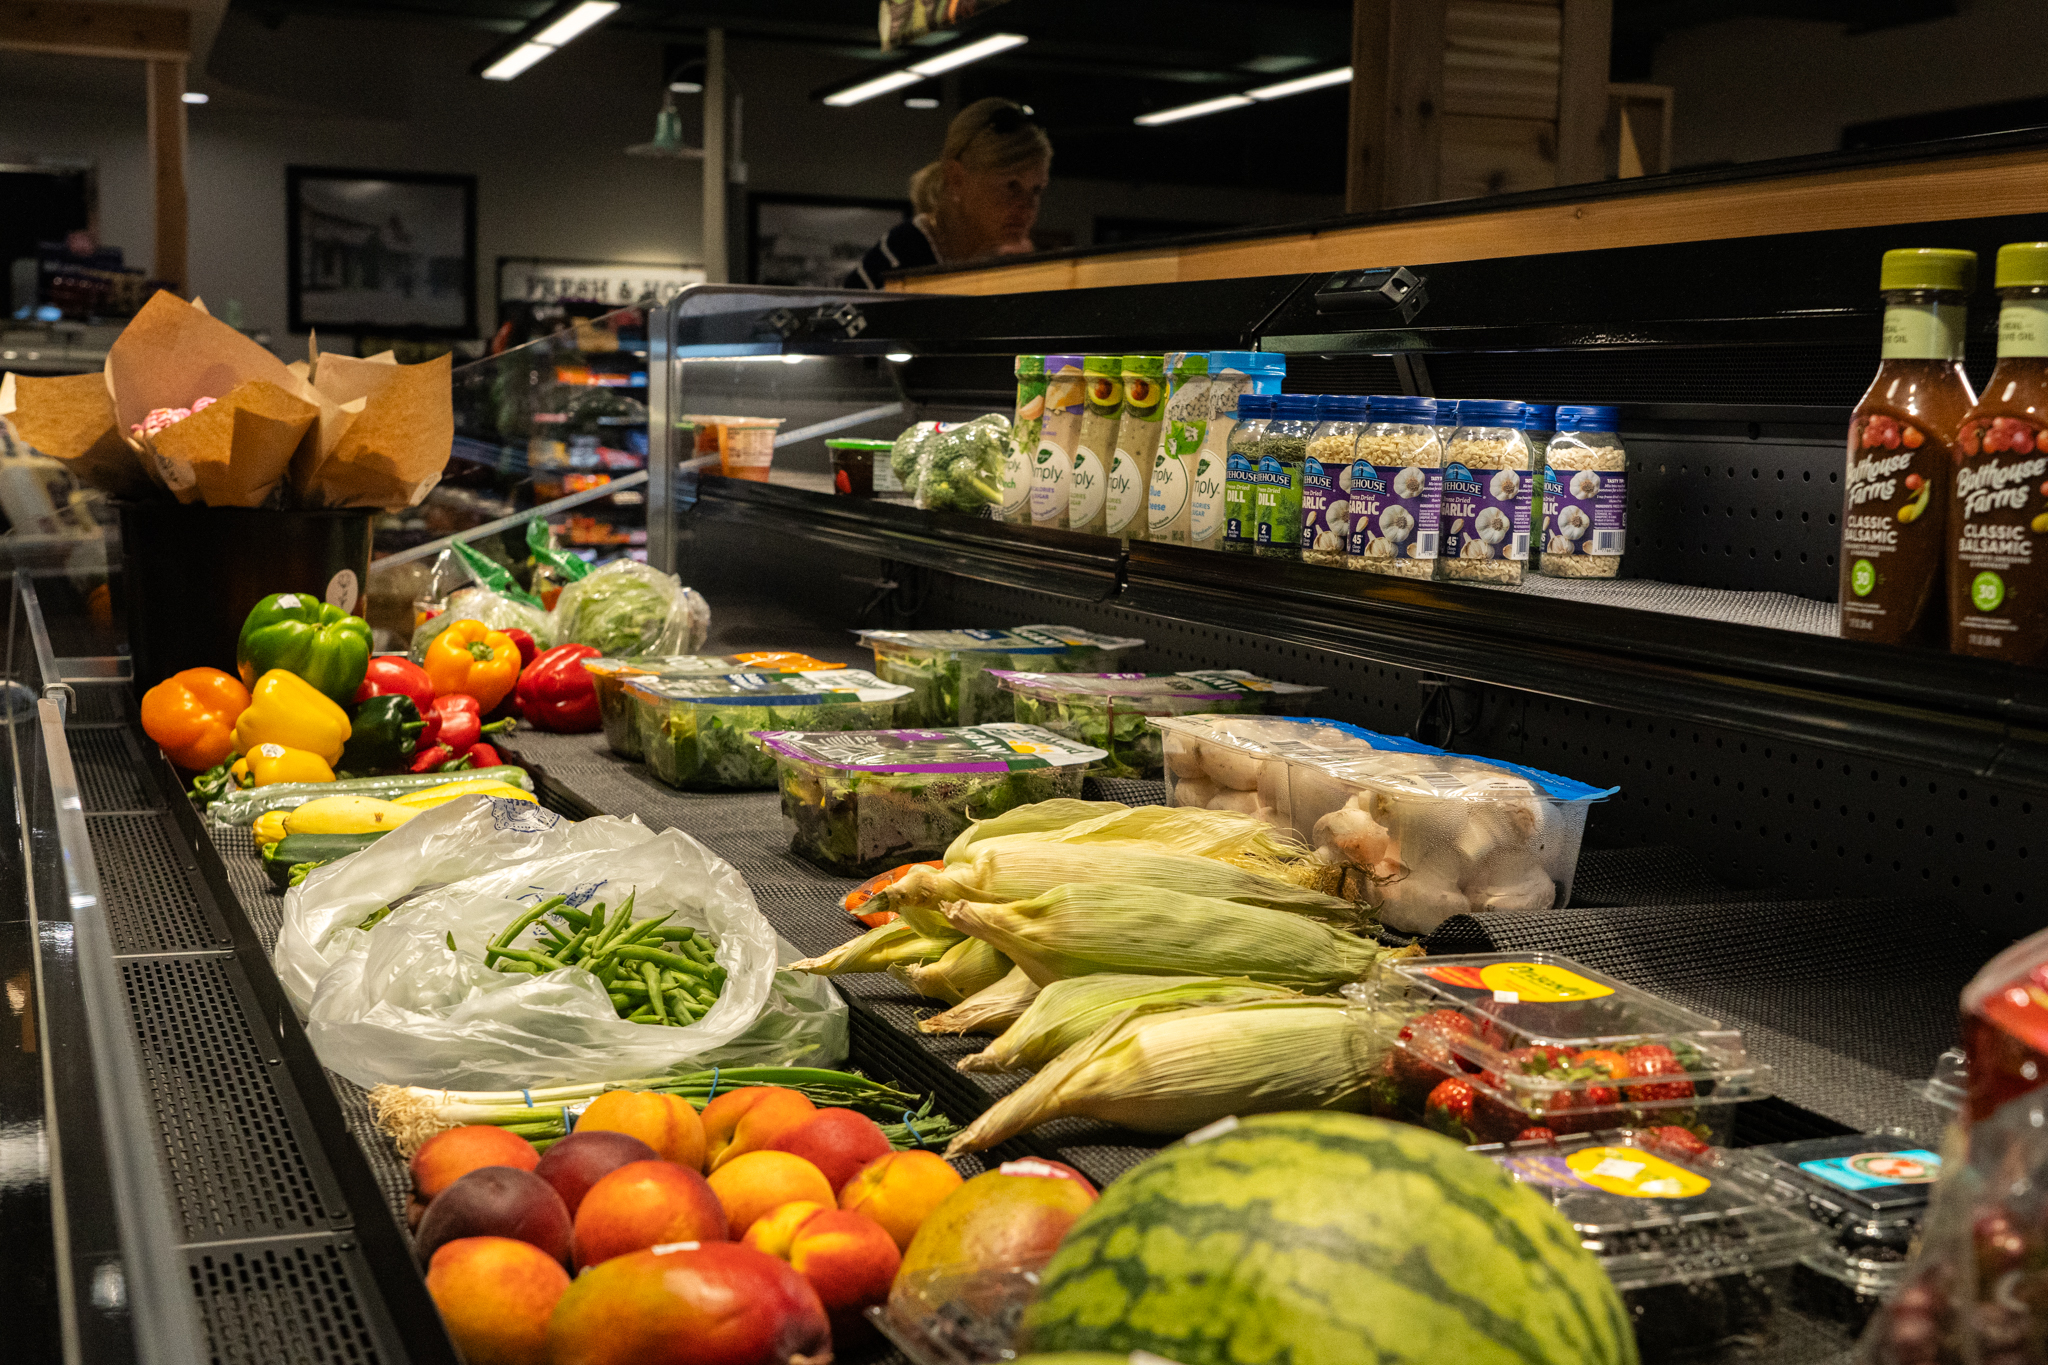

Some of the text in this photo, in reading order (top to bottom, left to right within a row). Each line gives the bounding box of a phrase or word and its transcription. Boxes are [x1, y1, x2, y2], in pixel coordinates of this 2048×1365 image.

[1034, 465, 1063, 483] mply
[1227, 471, 1258, 482] TEHOUSE
[1956, 457, 2046, 498] Bolthouse
[1304, 475, 1331, 488] EHOUSE
[1444, 481, 1482, 494] TEHOUSE
[1227, 490, 1245, 503] DILL
[1258, 493, 1276, 507] DILL
[1848, 478, 1897, 511] Farms
[1302, 496, 1326, 510] ARLIC
[1542, 503, 1558, 515] RLIC
[1964, 485, 2031, 520] Farms
[1441, 503, 1476, 517] GARLIC
[1848, 514, 1892, 530] CLASSIC
[1844, 528, 1898, 545] BALSAMIC
[1963, 523, 2025, 540] CLASSIC
[1352, 535, 1362, 545] 45
[1447, 536, 1457, 546] 45
[1958, 538, 2032, 556] BALSAMIC
[1978, 584, 1998, 600] 30
